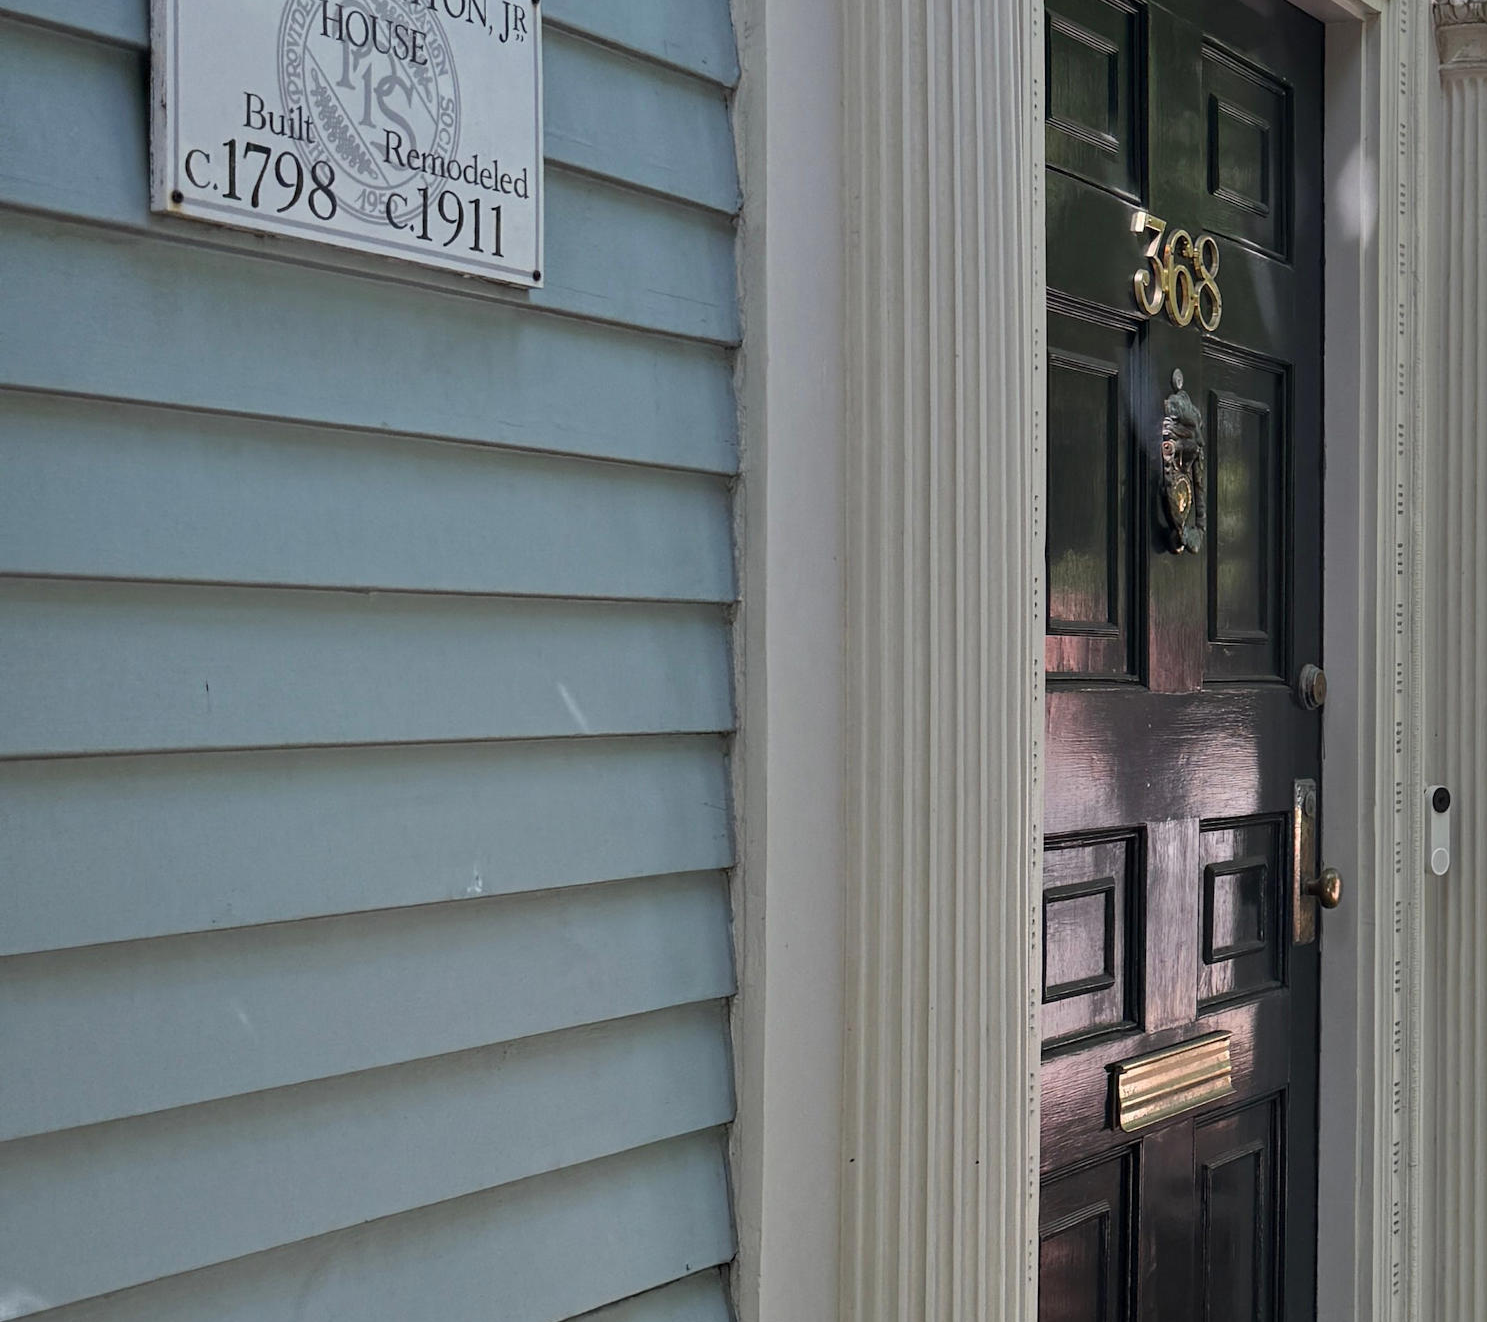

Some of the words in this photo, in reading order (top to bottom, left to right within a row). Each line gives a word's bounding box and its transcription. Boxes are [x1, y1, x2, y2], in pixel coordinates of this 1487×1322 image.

[243, 91, 315, 144] Built
[382, 128, 530, 199] Remodeled
[1130, 211, 1222, 332] 368
